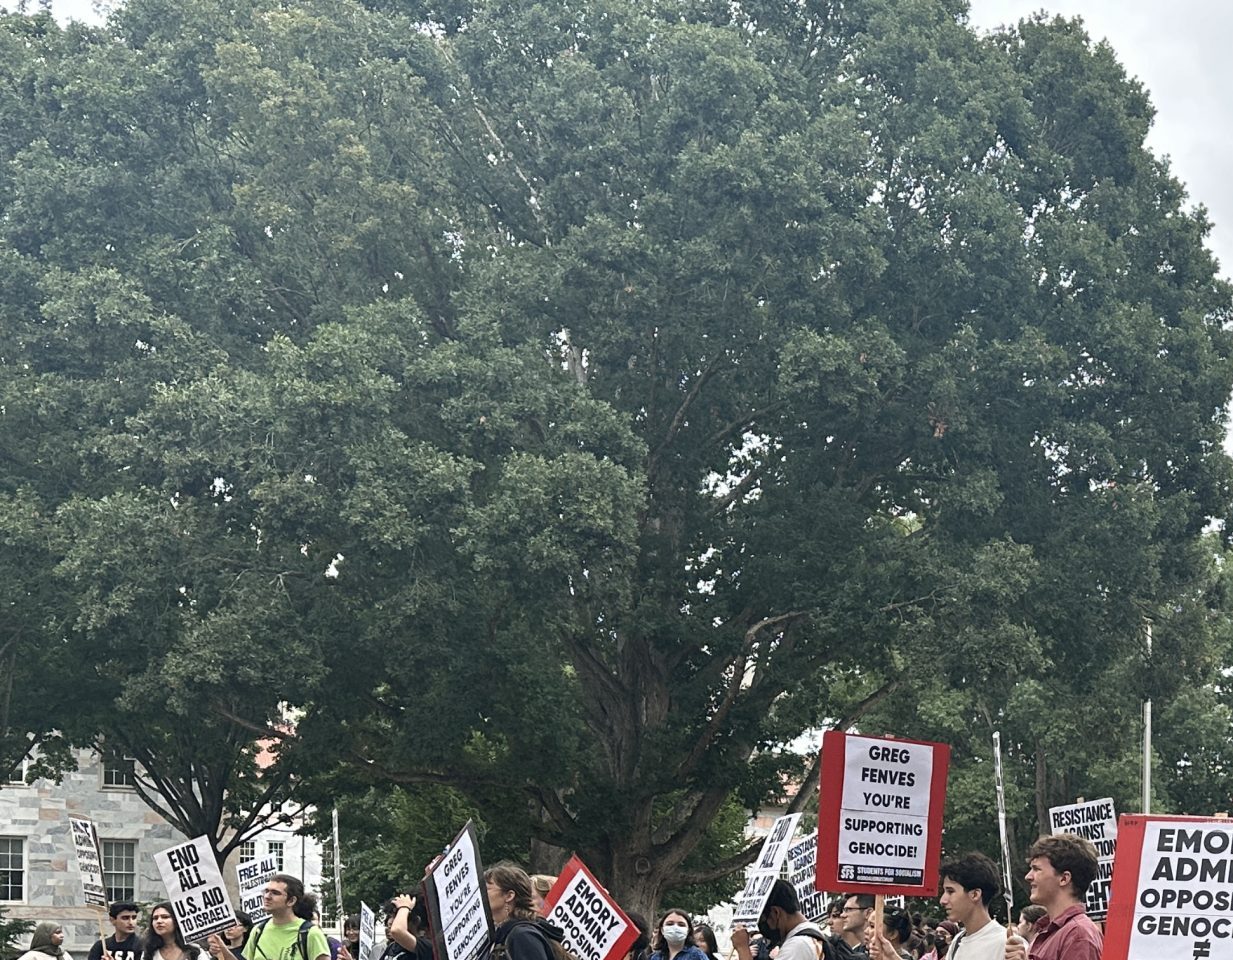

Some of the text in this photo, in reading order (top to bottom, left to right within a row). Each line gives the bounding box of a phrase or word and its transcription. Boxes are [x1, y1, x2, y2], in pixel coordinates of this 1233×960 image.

[868, 745, 911, 764] GREG
[861, 767, 916, 787] FENVES
[862, 791, 911, 809] YOU'RE
[844, 817, 923, 836] SUPPORTING
[1052, 803, 1113, 829] RESISTANCE
[167, 843, 200, 873] END
[443, 848, 463, 877] GREG
[848, 841, 918, 858] GENOCIDE!
[178, 866, 207, 892] ALL
[238, 858, 276, 882] FREE ALL
[445, 862, 470, 899] FENVES
[857, 866, 884, 875] STUDENTS
[175, 886, 225, 919] U.S. AID
[243, 894, 264, 912] POLIT
[449, 882, 471, 915] YOU'RE
[574, 878, 620, 932] EMORY
[800, 891, 827, 919] IGHT!
[180, 918, 194, 933] TO
[193, 904, 231, 929] ISRAEL!
[447, 898, 481, 946] SUPPORTING
[564, 894, 608, 949] ADMIN:
[453, 917, 483, 960] GENOCIDE!
